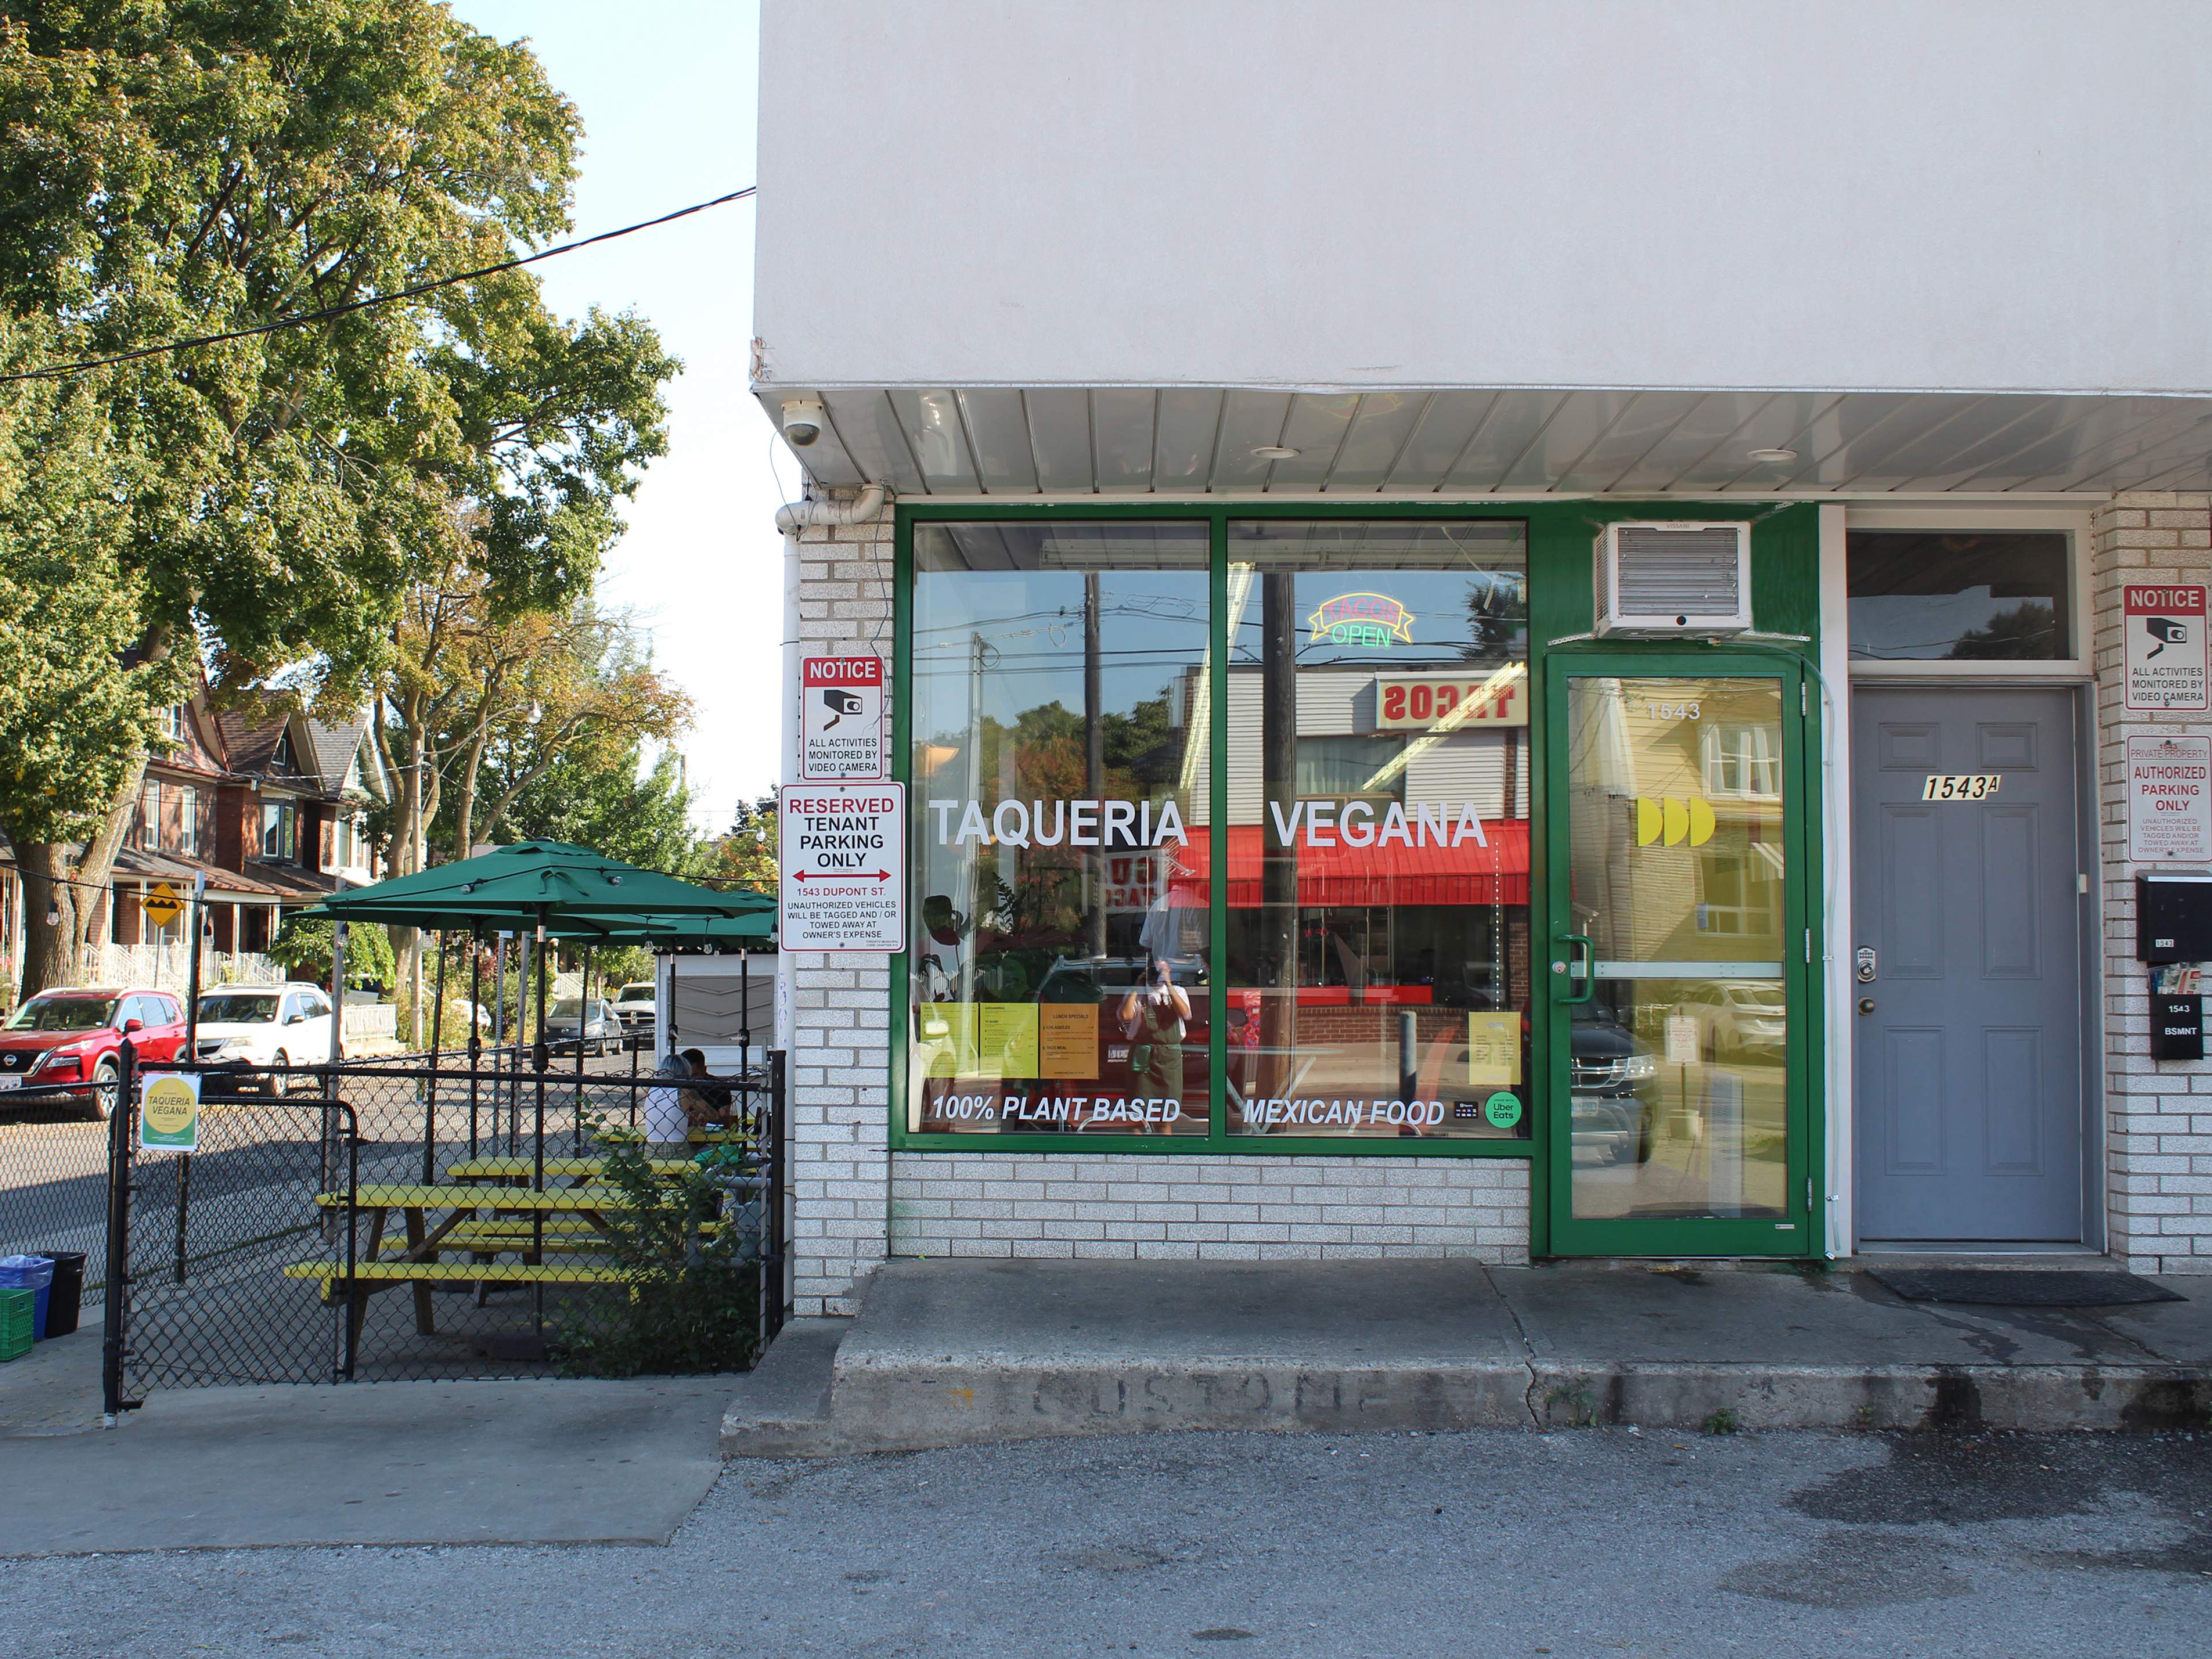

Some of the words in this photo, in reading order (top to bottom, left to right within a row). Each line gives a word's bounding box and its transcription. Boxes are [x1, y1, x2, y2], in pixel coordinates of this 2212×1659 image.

[2131, 590, 2199, 607] NOTICE
[1325, 598, 1400, 623] TACOS
[1332, 624, 1391, 647] OPEN
[810, 661, 876, 679] NOTICE
[2133, 668, 2150, 676] ALL
[2153, 668, 2203, 676] ACTIVITIES
[2133, 680, 2188, 688] MONITORED
[2191, 680, 2203, 688] BY
[2133, 692, 2161, 701] VIDEO
[2163, 692, 2203, 701] CAMERA
[1647, 703, 1700, 720] 1543
[809, 738, 826, 747] ALL
[828, 738, 877, 747] ACTIVITIES
[809, 751, 862, 759] MONITORED
[865, 751, 877, 759] BY
[2131, 749, 2163, 758] PRIVATE
[2165, 749, 2208, 758] PROPERTY
[809, 763, 836, 772] VIDEO
[839, 763, 877, 771] CAMERA
[2134, 767, 2206, 779] AUTHORIZED
[2142, 785, 2199, 796] PARKING
[790, 798, 894, 813] RESERVED
[2156, 800, 2190, 810] ONLY
[804, 817, 879, 831] TENANT
[929, 799, 1189, 849] TAQUERIA
[1270, 801, 1487, 847] VEGANA
[801, 835, 884, 849] PARKING
[817, 853, 867, 868] ONLY
[797, 888, 820, 896] 1543
[823, 887, 868, 896] DUPONT
[871, 887, 886, 896] ST.
[787, 902, 853, 910] UNAUTHORIZED
[149, 1096, 190, 1106] TAQUERIA
[153, 1106, 187, 1115] VEGANA
[933, 1095, 995, 1120] 100%
[1002, 1096, 1087, 1121] PLANT
[1092, 1097, 1180, 1122] BASED
[1243, 1099, 1366, 1124] MEXICAN
[1370, 1100, 1445, 1125] FOOD
[1494, 1111, 1514, 1119] Eats
